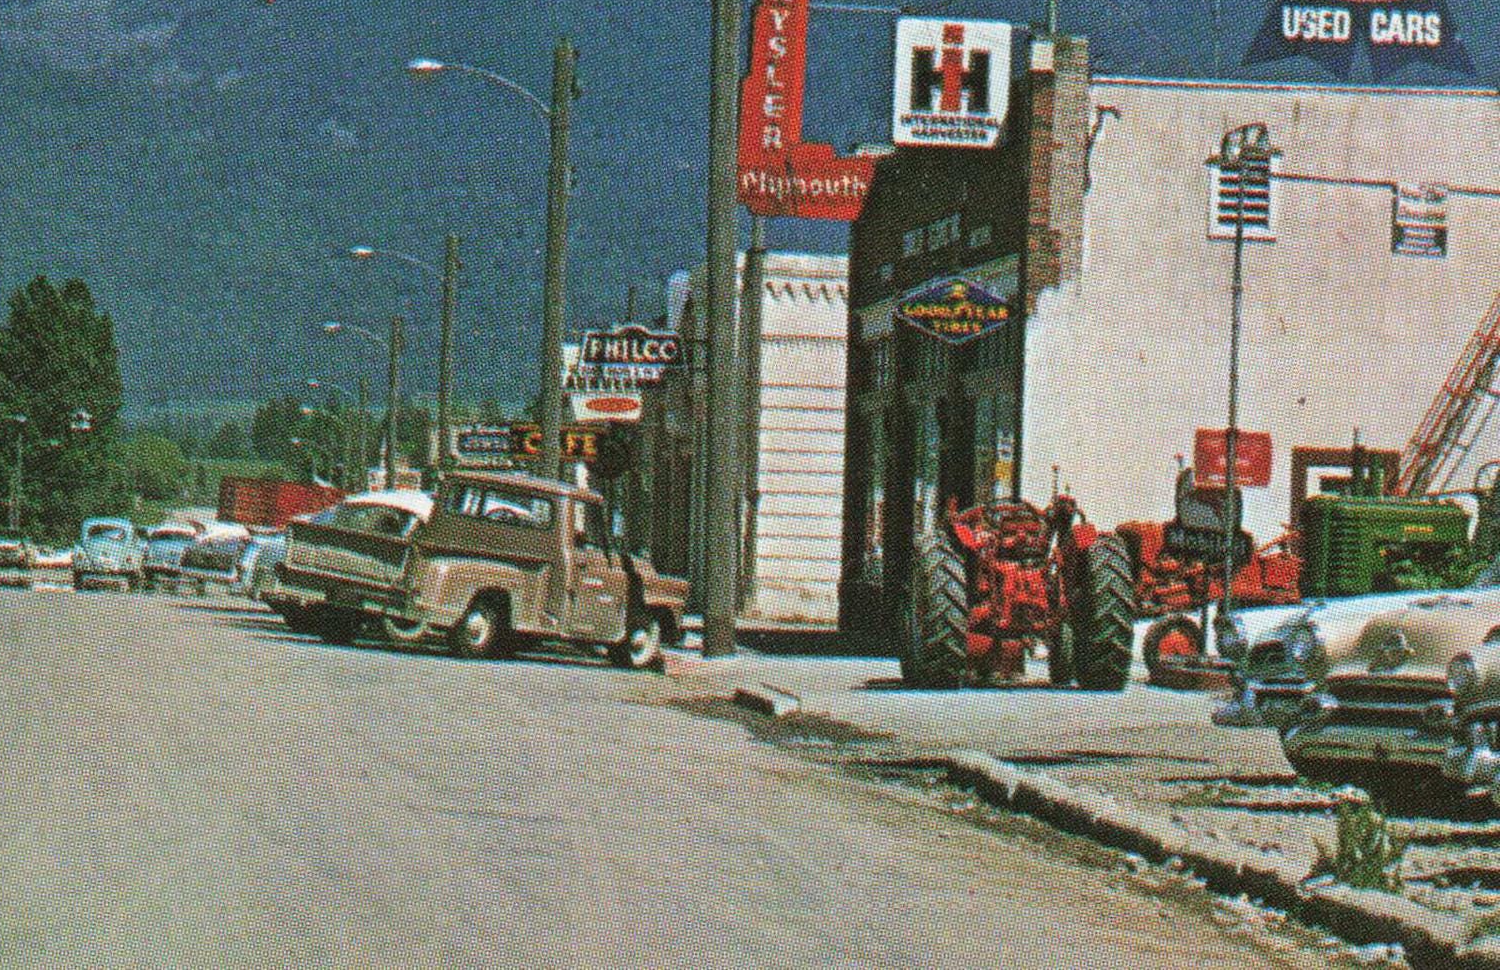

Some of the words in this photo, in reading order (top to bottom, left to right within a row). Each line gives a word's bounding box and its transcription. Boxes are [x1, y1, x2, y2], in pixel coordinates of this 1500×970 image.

[1282, 7, 1350, 40] USED
[1370, 11, 1441, 45] CARS
[910, 128, 988, 141] HARVESTER
[742, 171, 868, 200] Plymouth
[589, 338, 678, 362] PHILCO
[523, 431, 598, 455] CFE
